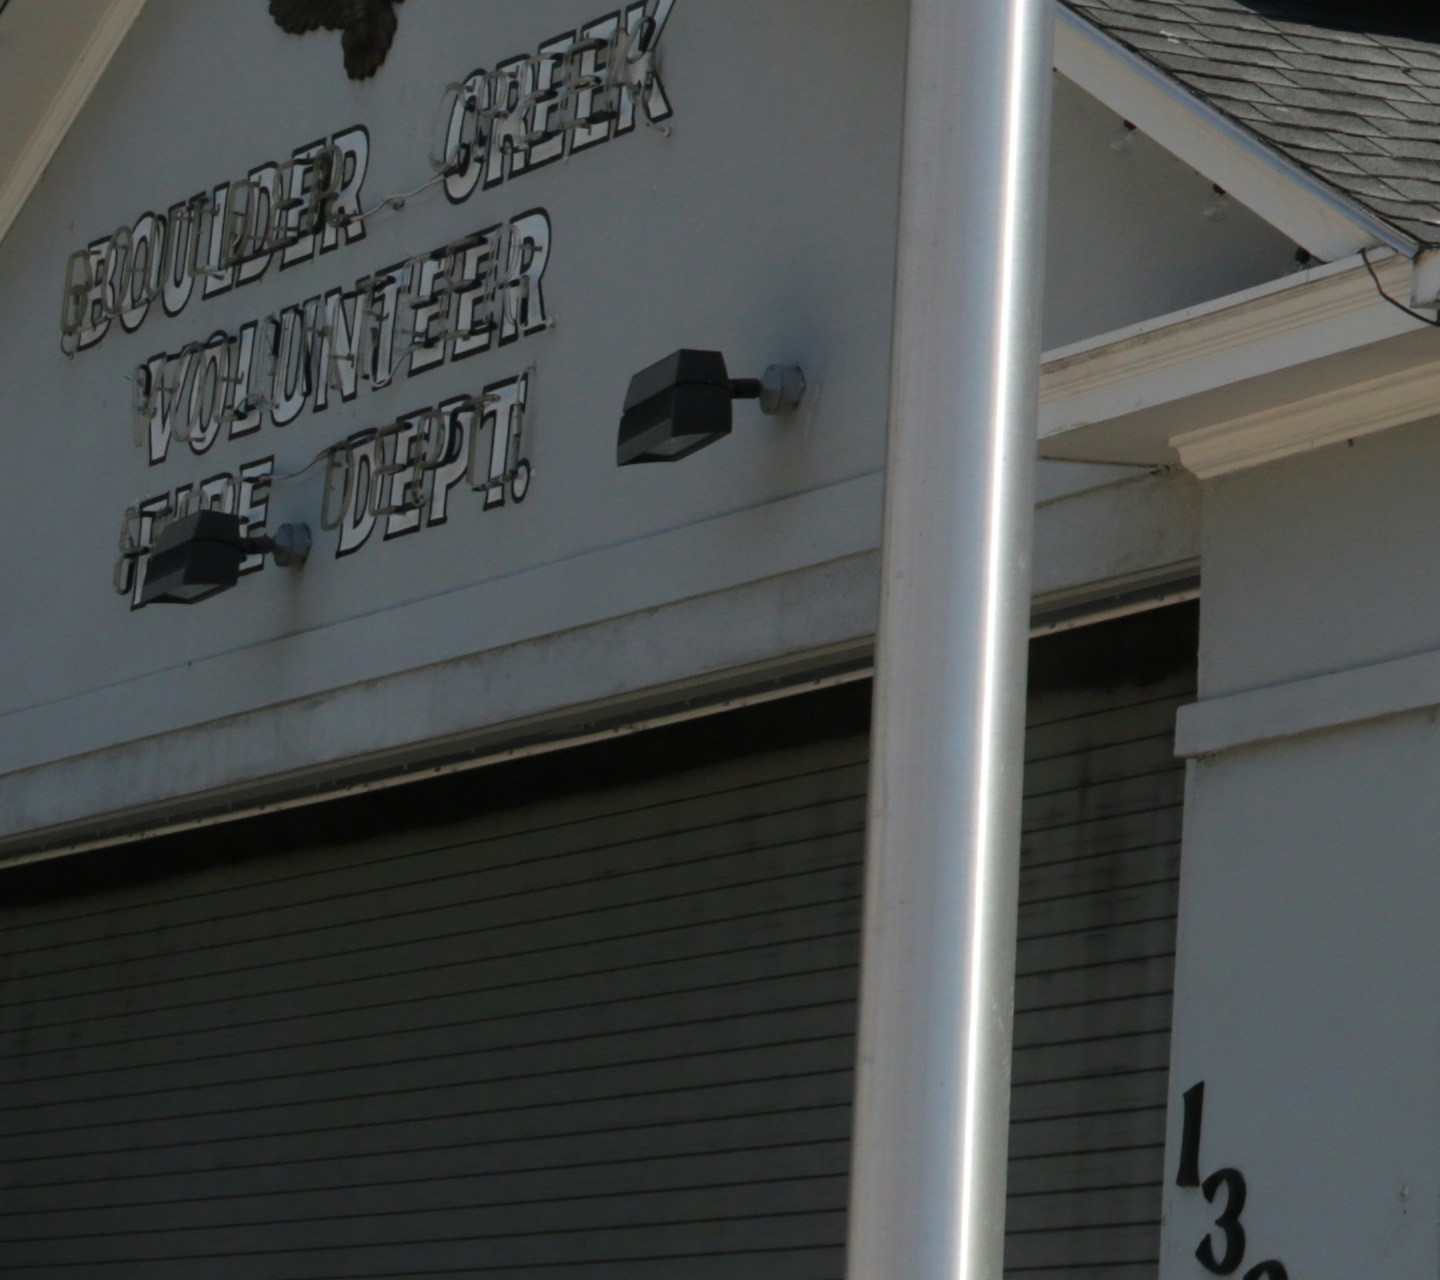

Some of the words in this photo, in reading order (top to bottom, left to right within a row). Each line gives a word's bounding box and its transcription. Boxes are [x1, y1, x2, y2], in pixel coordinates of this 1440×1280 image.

[60, 124, 369, 357] BOULDER
[135, 207, 553, 465] VOLUNTEER
[1176, 1080, 1288, 1280] 13
